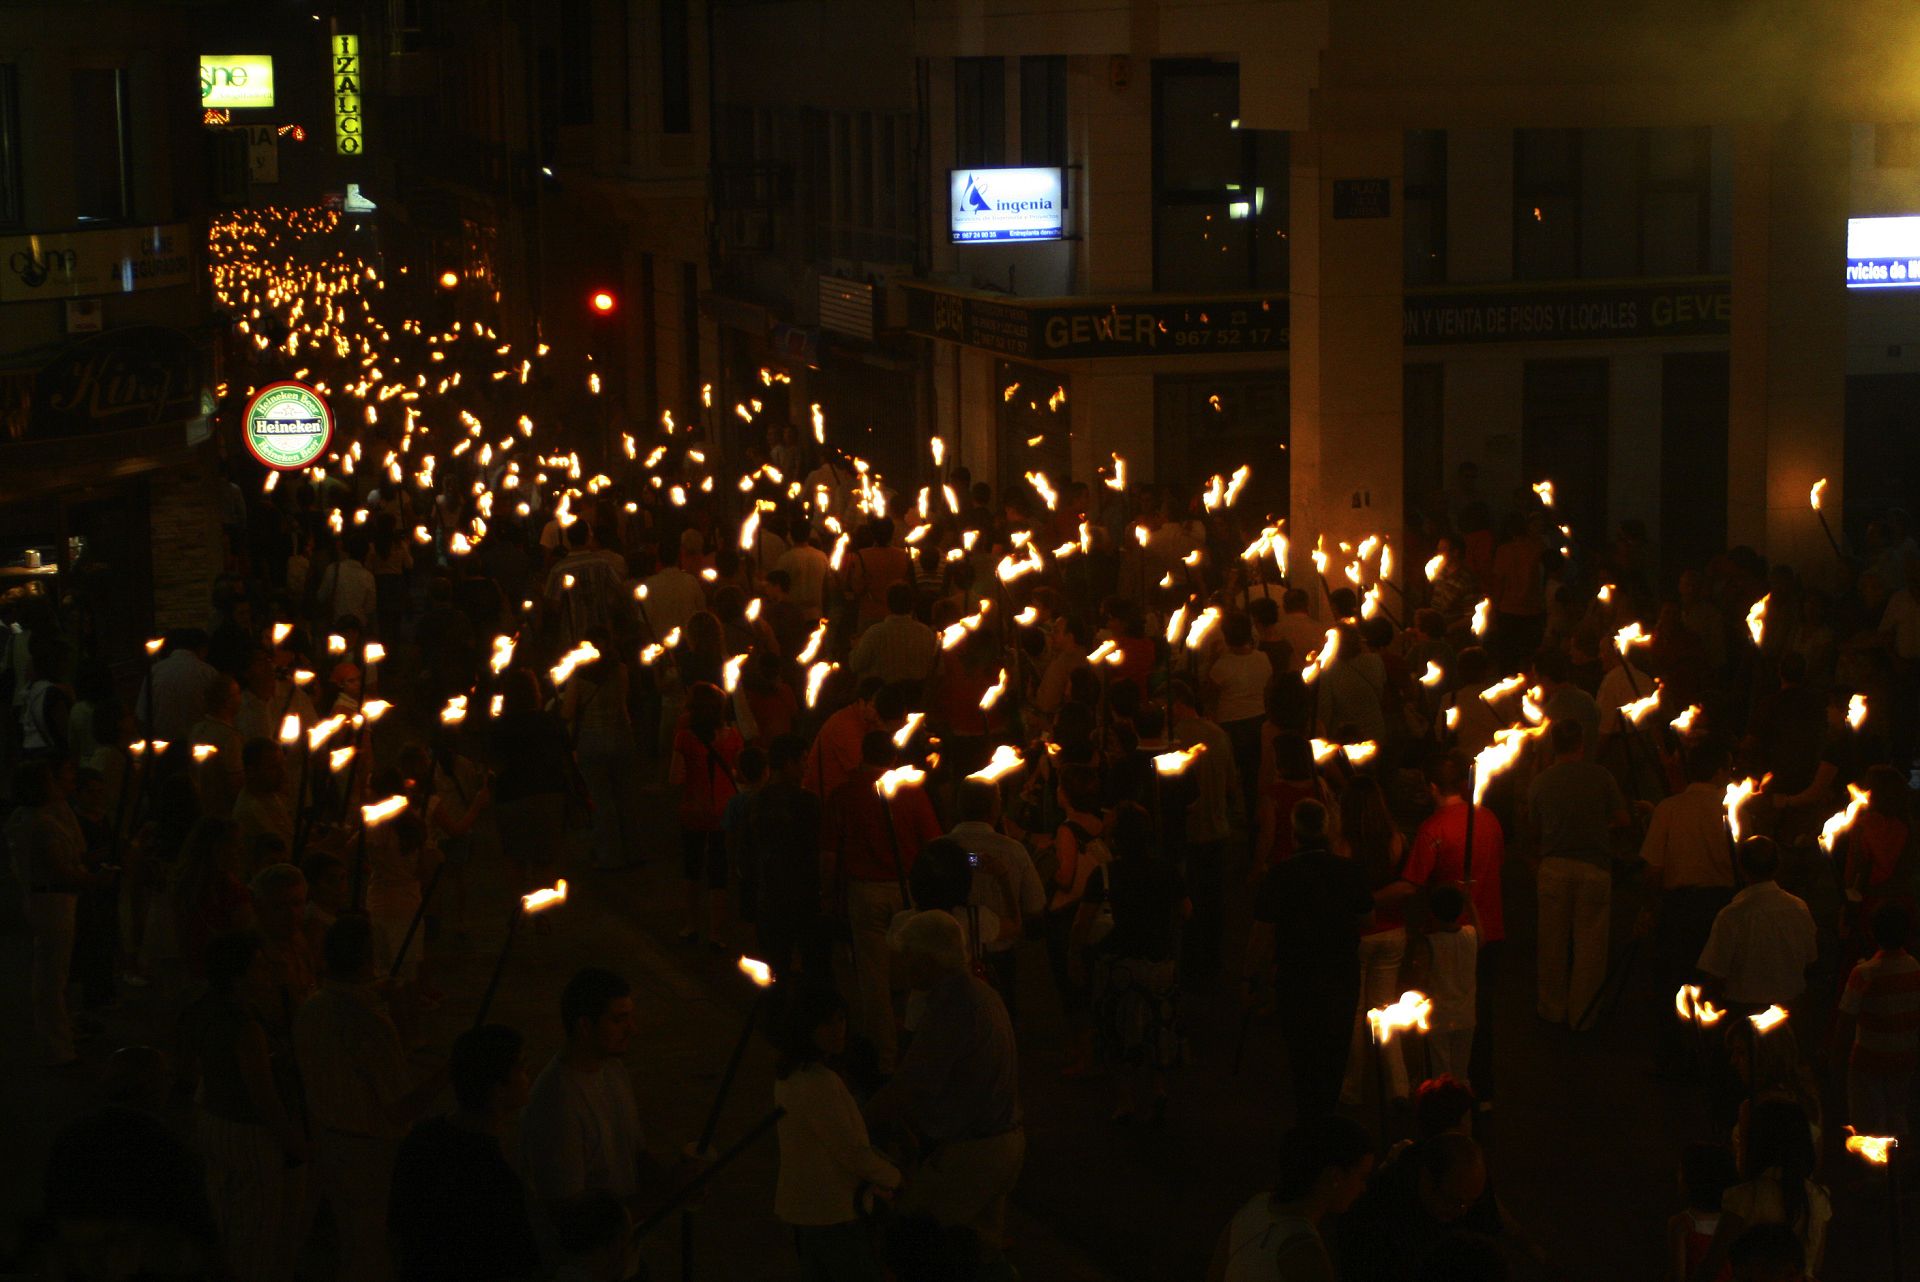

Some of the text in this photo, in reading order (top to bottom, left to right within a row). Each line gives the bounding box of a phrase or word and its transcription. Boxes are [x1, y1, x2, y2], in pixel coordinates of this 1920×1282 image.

[337, 36, 359, 154] IZALCO
[996, 197, 1053, 213] ingenia
[1422, 308, 1432, 336] Y
[1436, 306, 1483, 336] VENTA
[1487, 305, 1506, 333] DE
[1510, 303, 1553, 333] PISOS
[1557, 304, 1568, 331] Y
[1571, 301, 1638, 331] LOCALES
[1175, 329, 1211, 346] 967
[1217, 329, 1241, 345] 52
[1249, 327, 1272, 344] 17
[257, 391, 319, 414] Heineken Beer
[256, 420, 321, 434] Heineken
[258, 439, 319, 462] Heineken Beer
